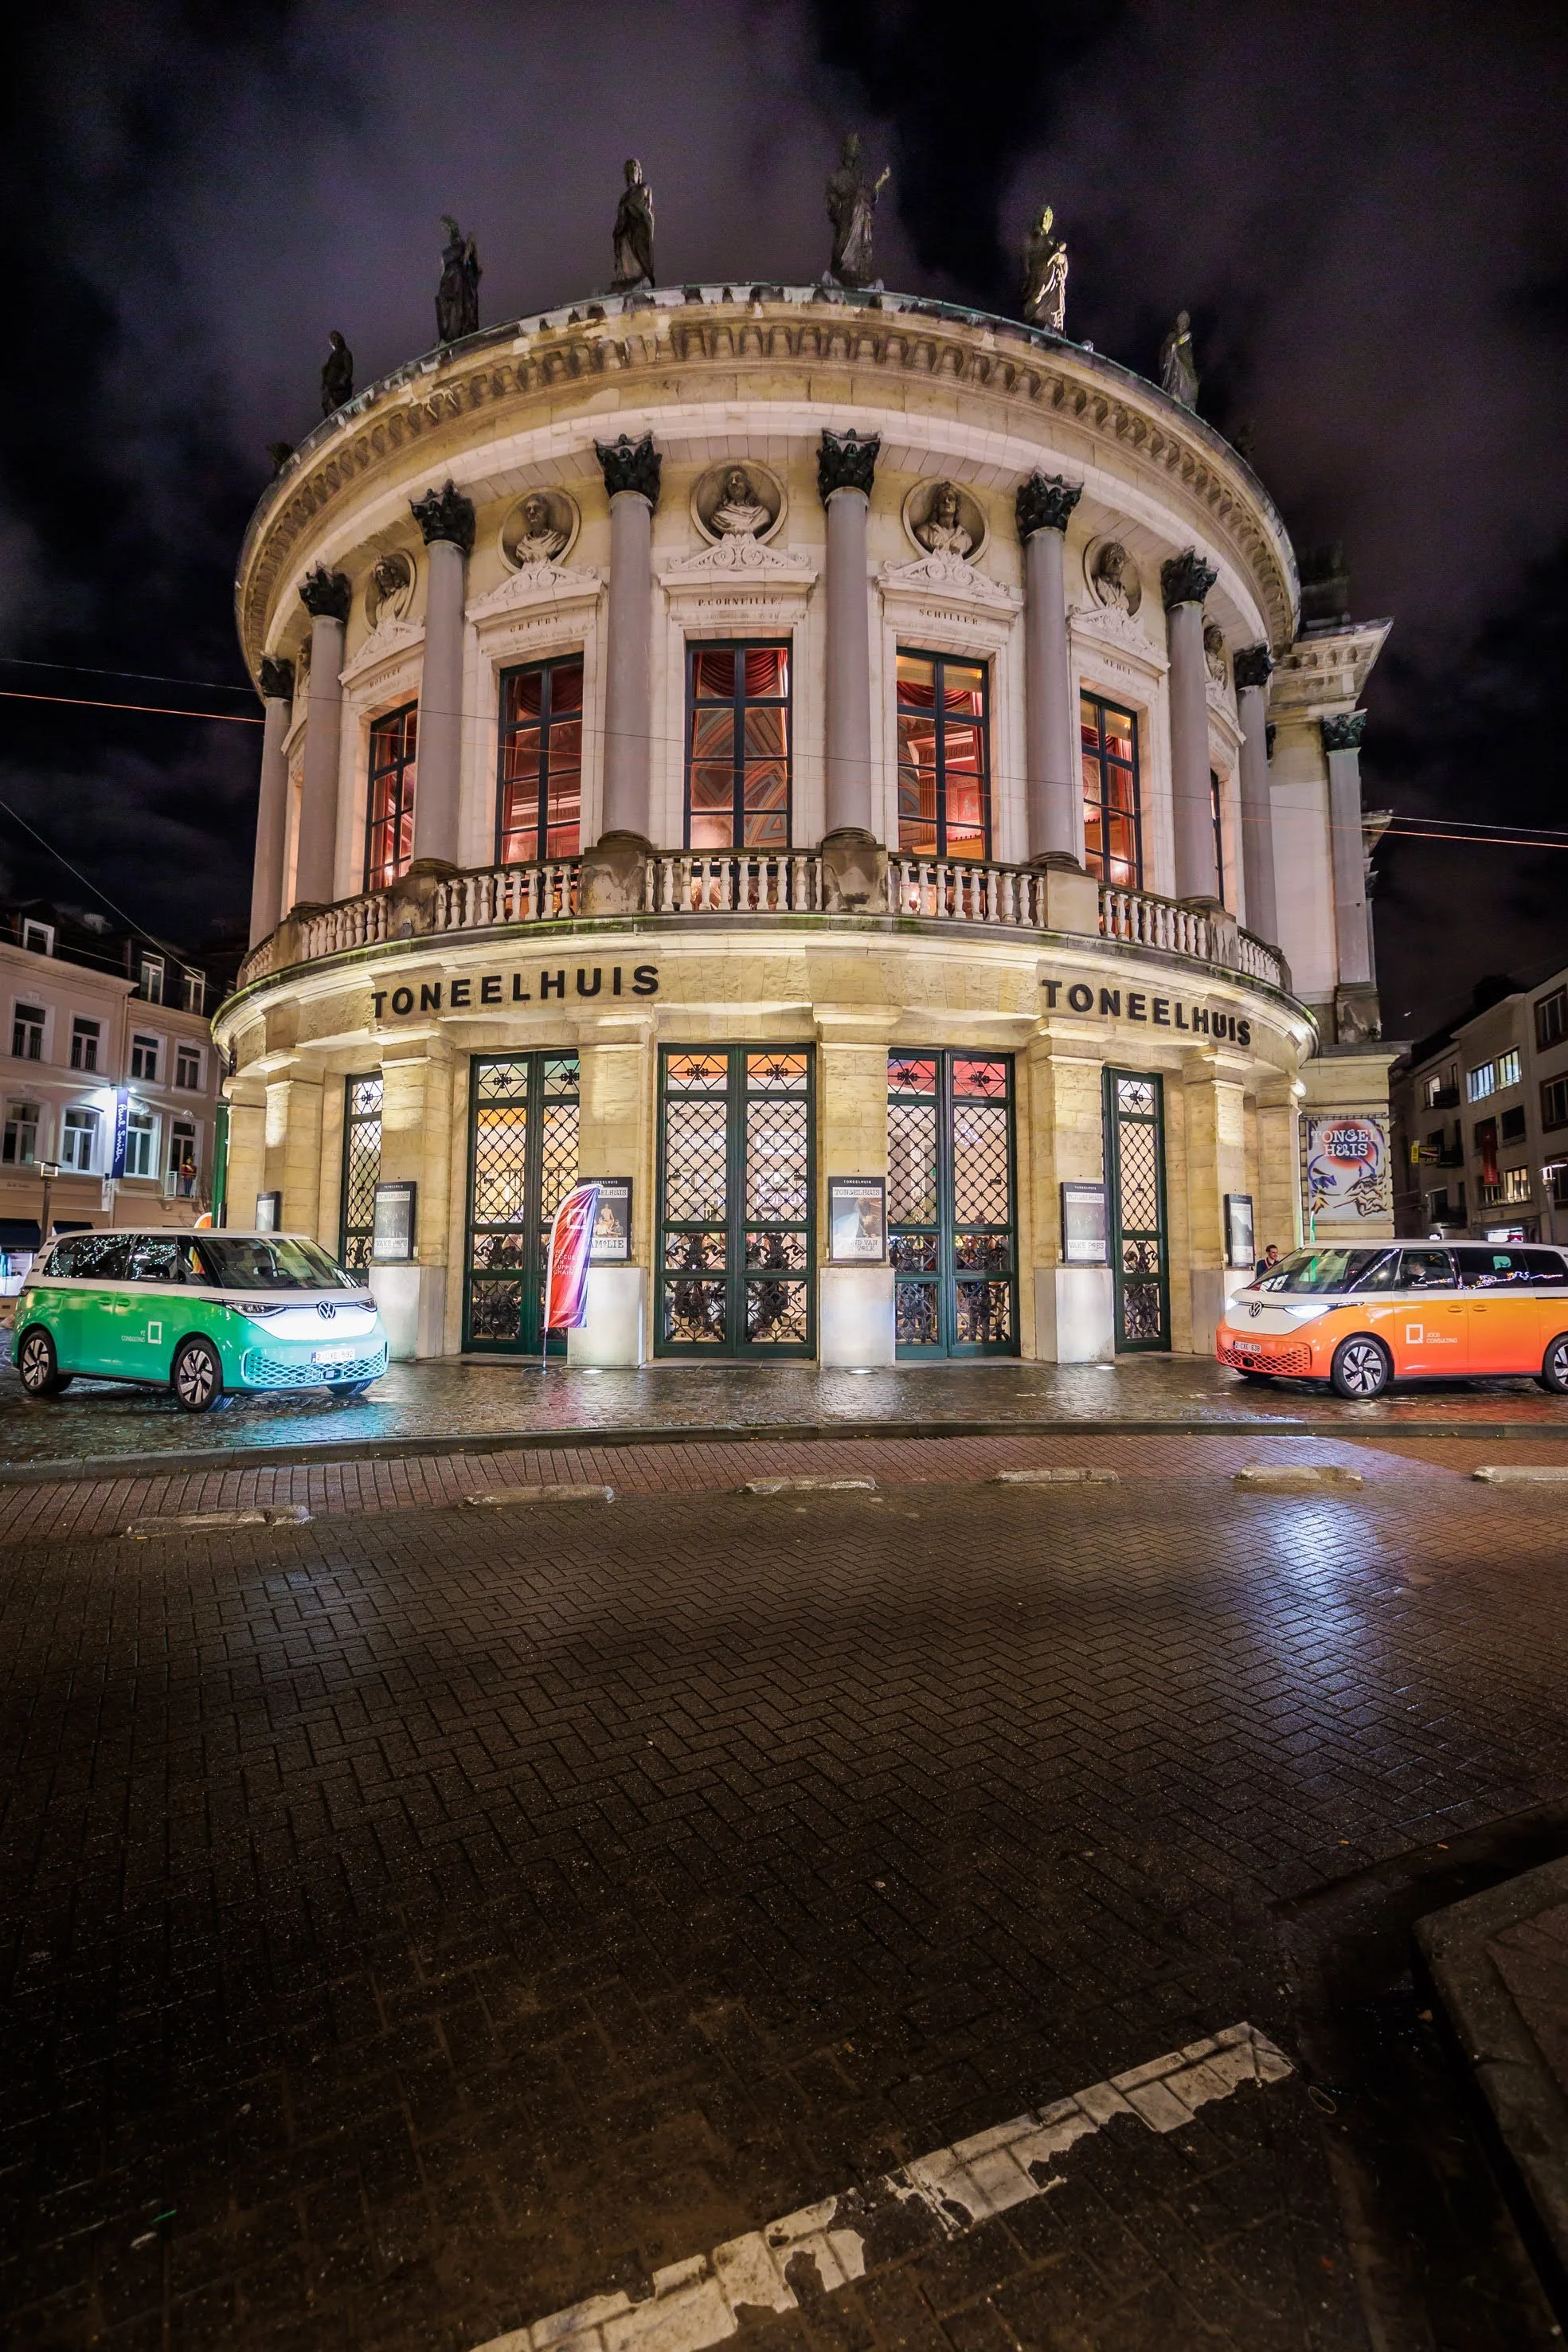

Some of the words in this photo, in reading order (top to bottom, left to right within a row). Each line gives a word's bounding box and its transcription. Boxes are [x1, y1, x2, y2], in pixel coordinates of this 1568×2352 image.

[371, 965, 659, 1018] TONEELHUIS
[1042, 979, 1251, 1045] TONEELHUIS
[117, 1103, 127, 1127] Paul
[115, 1130, 126, 1163] Smith
